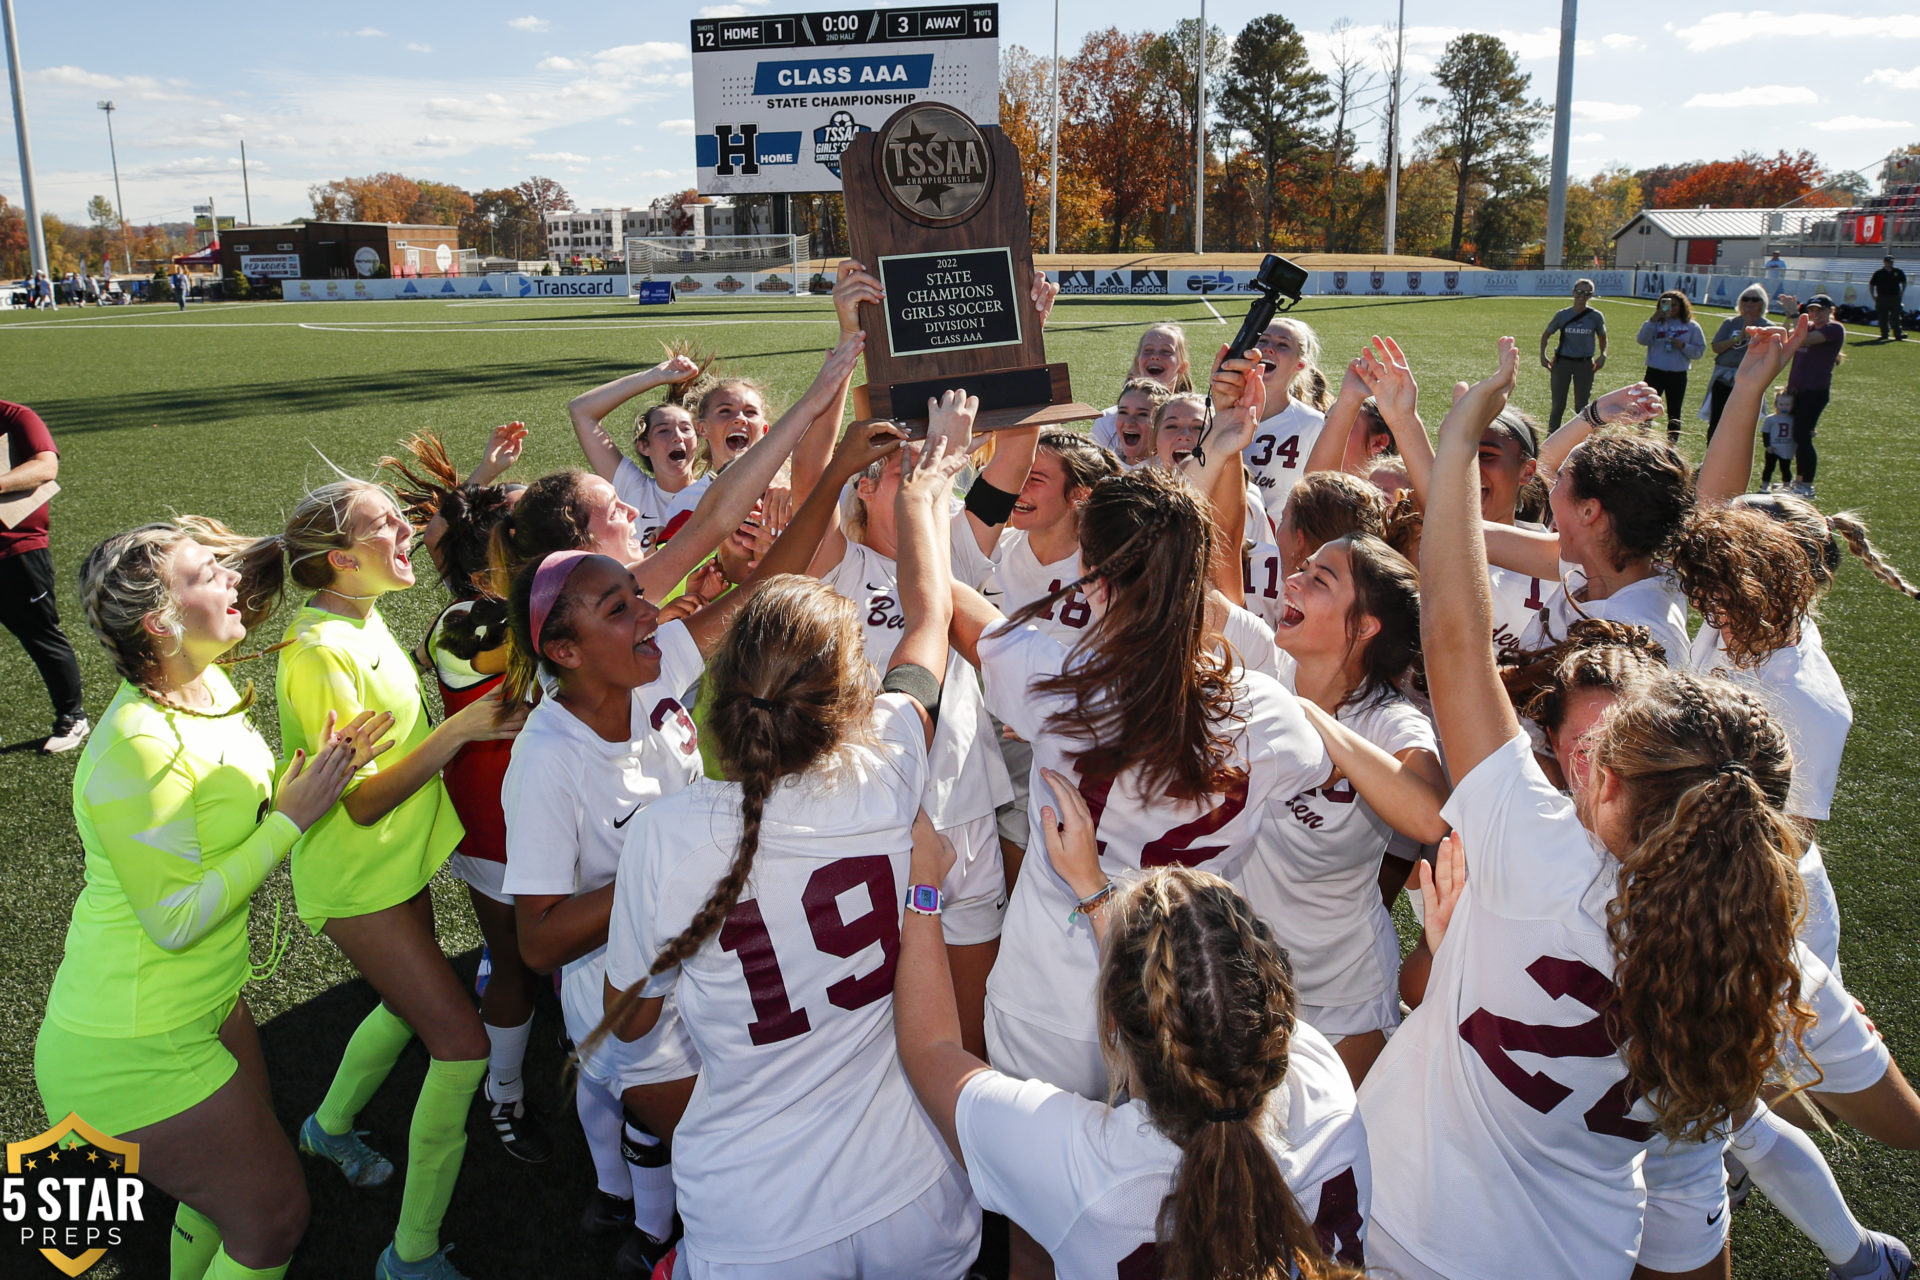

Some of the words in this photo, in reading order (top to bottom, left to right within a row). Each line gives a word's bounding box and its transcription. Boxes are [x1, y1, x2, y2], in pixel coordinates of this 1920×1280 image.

[775, 23, 783, 39] 1
[822, 15, 859, 32] 0:00
[898, 17, 909, 33] 3
[925, 16, 961, 30] AWAY
[973, 18, 992, 33] 10
[697, 33, 715, 47] 12
[724, 27, 760, 40] HOME
[777, 66, 852, 87] CLASS
[859, 64, 908, 83] AAA
[767, 97, 808, 109] STATE
[811, 94, 916, 107] CHAMPIONSHIP
[713, 122, 760, 177] H
[760, 153, 794, 164] HOME
[888, 141, 983, 177] TSSAA
[906, 176, 971, 185] CHAMPIONSHIPS
[937, 258, 958, 268] 2022
[533, 277, 613, 295] Transcard
[926, 270, 972, 286] STATE
[1187, 271, 1234, 294] epb
[907, 284, 994, 303] CHAMPIONS
[1060, 285, 1094, 294] adidas
[1096, 285, 1130, 294] adidas
[1132, 285, 1167, 294] adidas
[901, 305, 945, 321] GIRLS
[949, 300, 1003, 316] SOCCER
[925, 319, 978, 333] DIVISION
[980, 317, 985, 327] I
[930, 334, 961, 345] CLASS
[963, 332, 983, 342] AAA
[1778, 422, 1789, 438] B
[1251, 434, 1300, 469] 34
[1036, 578, 1092, 629] 18
[650, 697, 698, 756] 3
[718, 854, 902, 1047] 19
